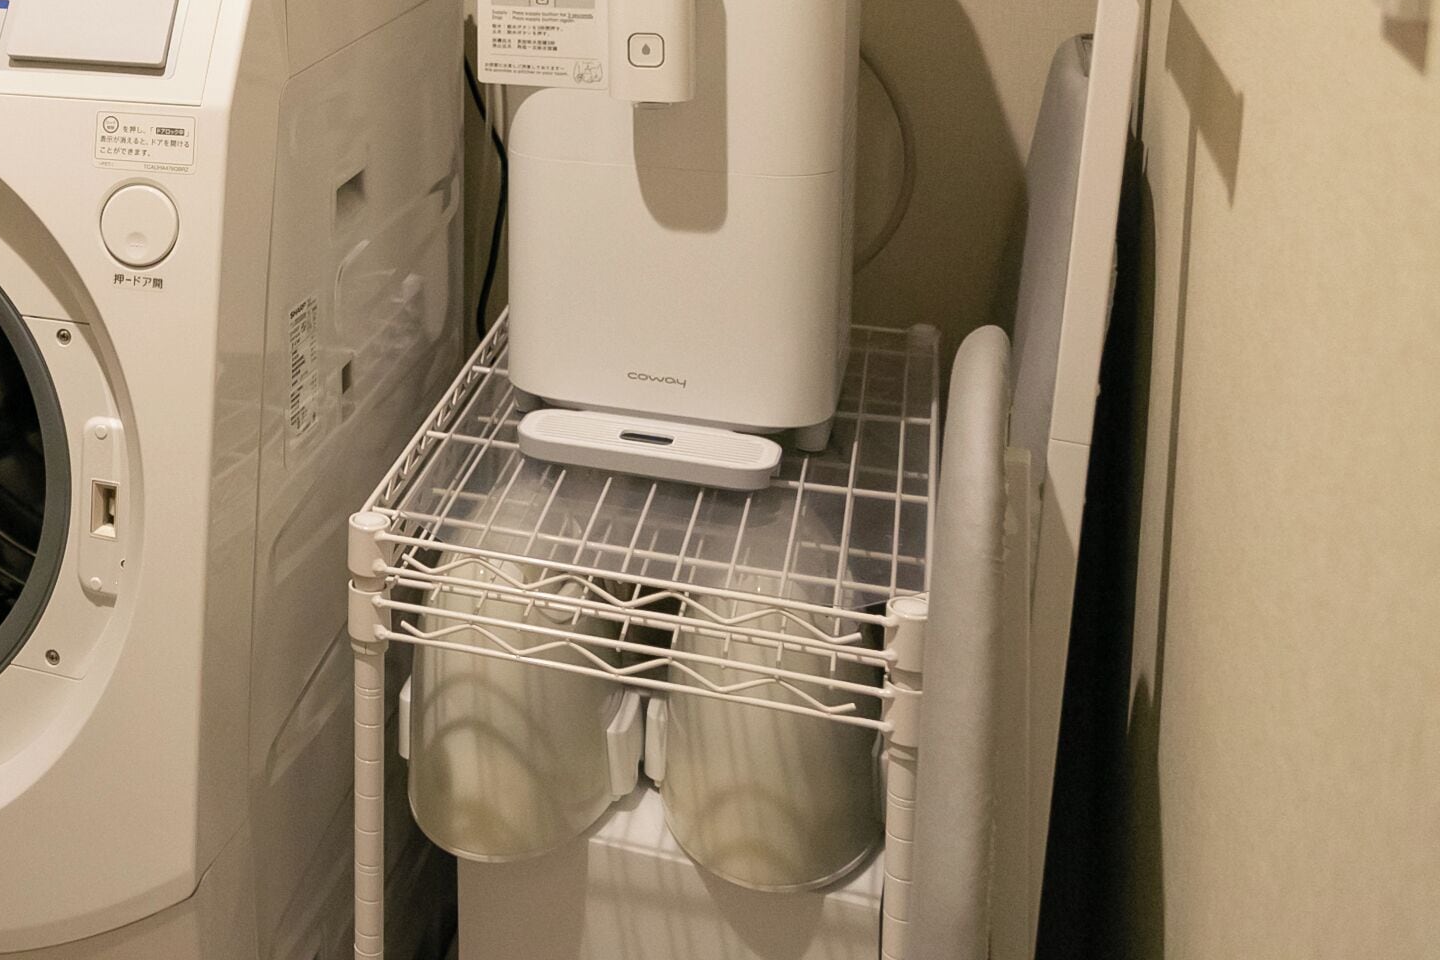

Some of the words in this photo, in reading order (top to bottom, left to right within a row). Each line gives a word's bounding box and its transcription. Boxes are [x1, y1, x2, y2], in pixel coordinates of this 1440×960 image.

[99, 146, 151, 158] ことができます。
[626, 372, 687, 389] coway
